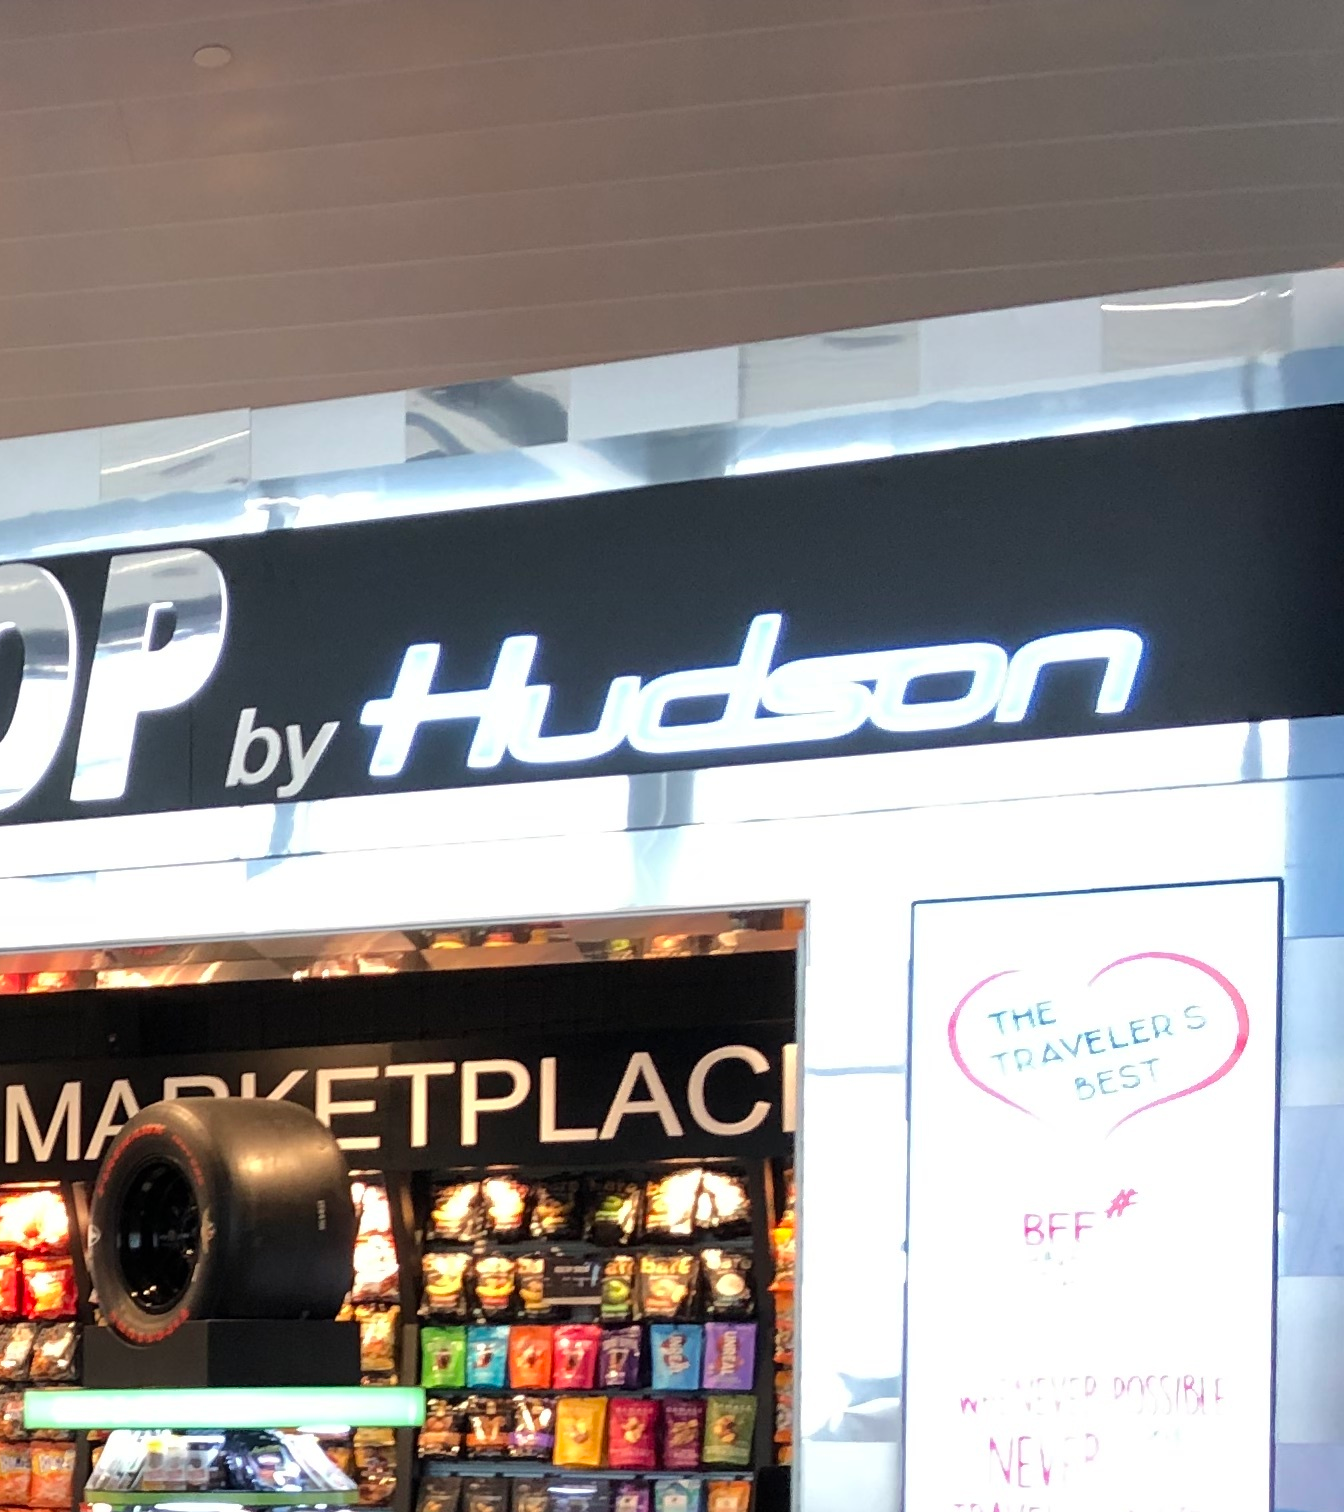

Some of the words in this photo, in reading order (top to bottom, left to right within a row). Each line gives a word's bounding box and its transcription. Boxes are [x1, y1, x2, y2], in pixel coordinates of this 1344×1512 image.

[225, 707, 340, 797] by
[359, 613, 1144, 778] Hudson
[988, 1000, 1056, 1035] THE
[1074, 1057, 1160, 1101] BEST
